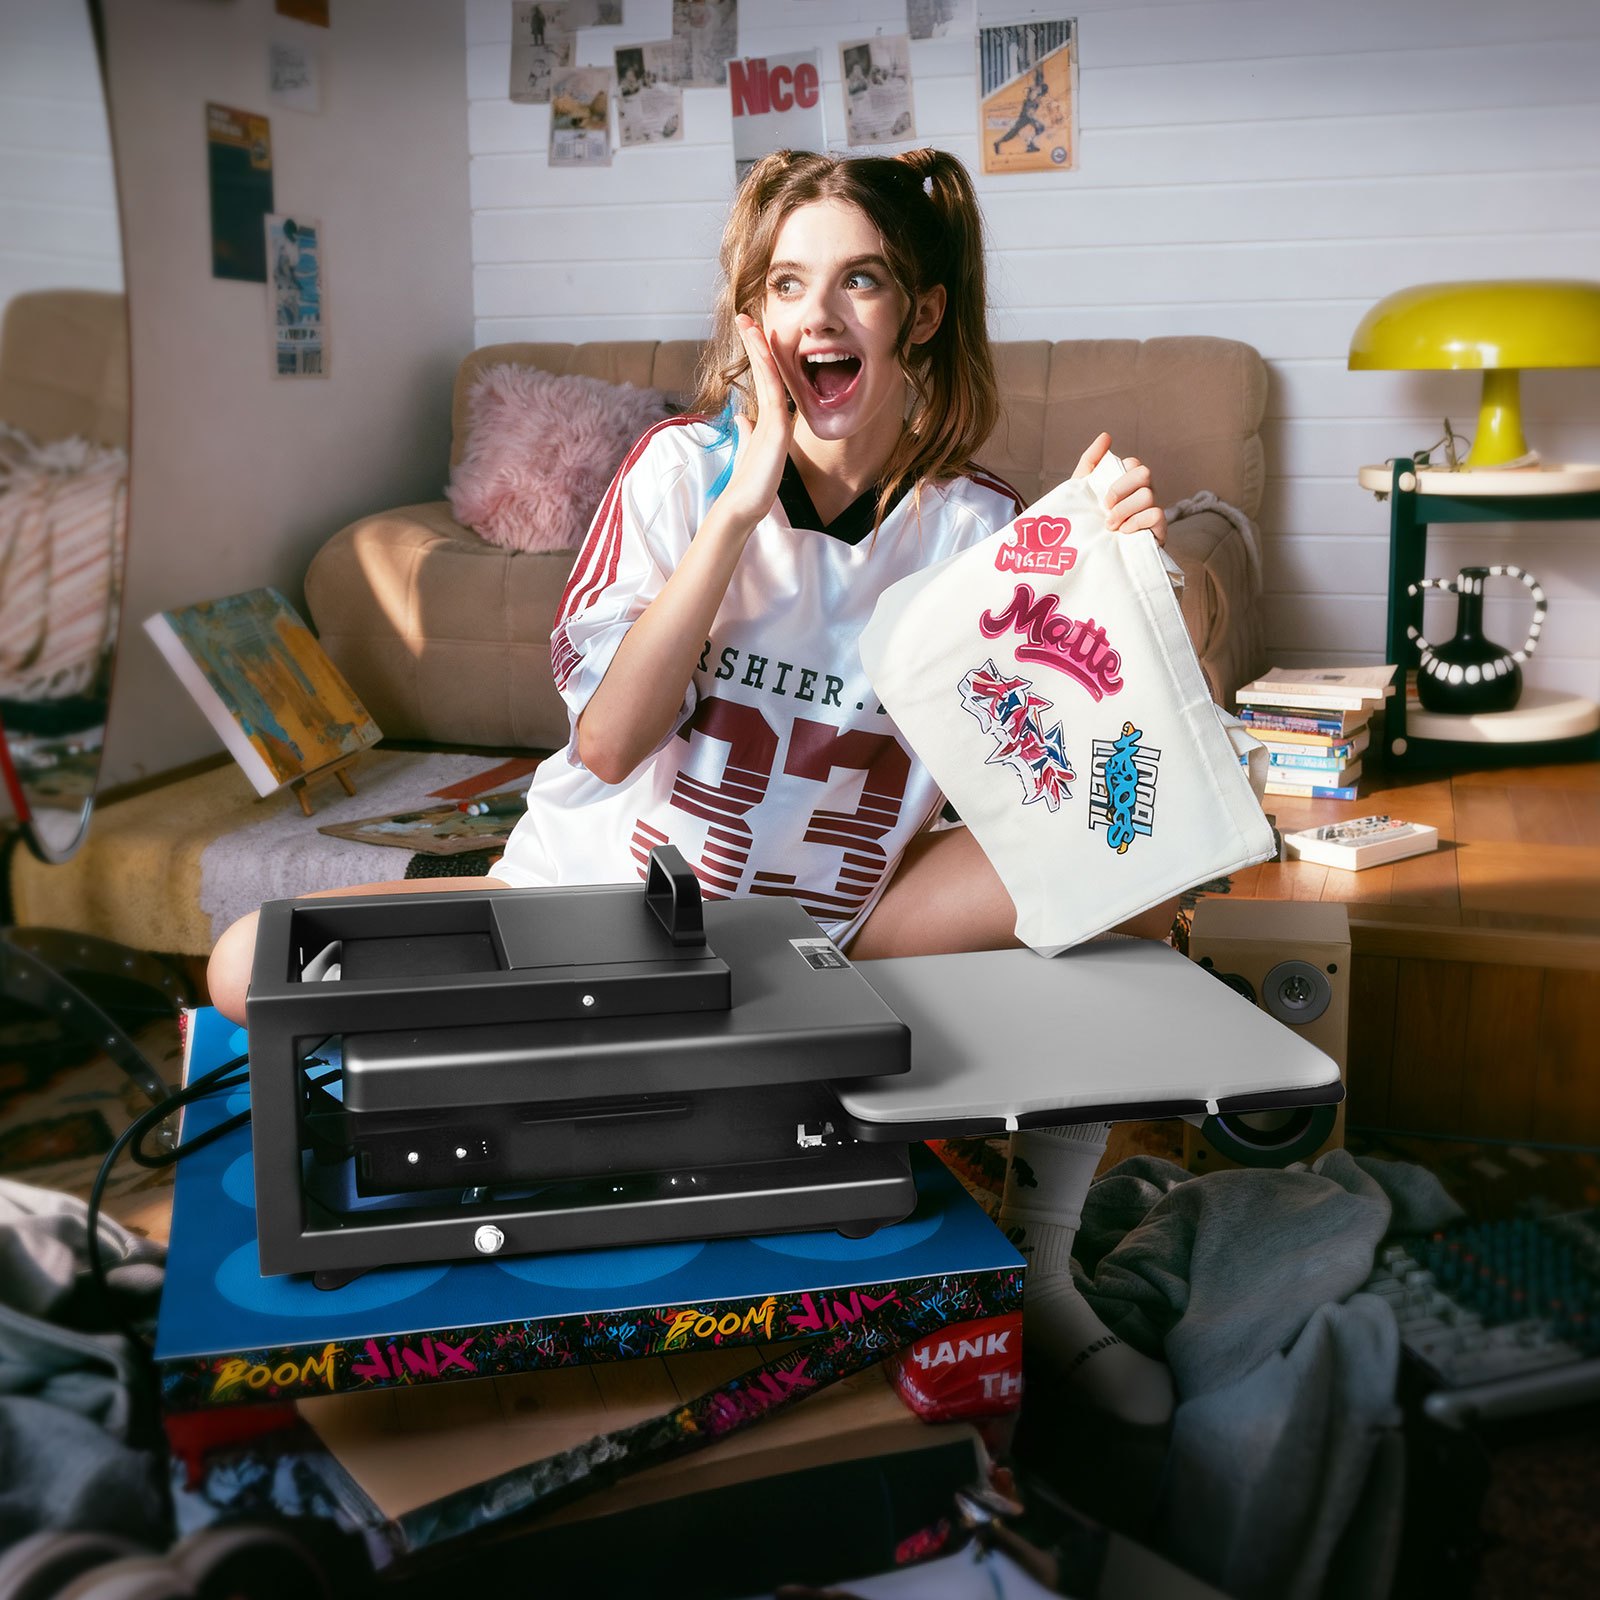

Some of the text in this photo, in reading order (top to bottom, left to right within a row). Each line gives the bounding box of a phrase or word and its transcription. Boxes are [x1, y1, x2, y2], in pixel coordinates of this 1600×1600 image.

[730, 57, 819, 117] Nice
[979, 583, 1124, 702] Matte
[697, 640, 887, 715] SHIER.
[666, 1296, 778, 1350] BOOM
[210, 1336, 481, 1400] BOOM JINX
